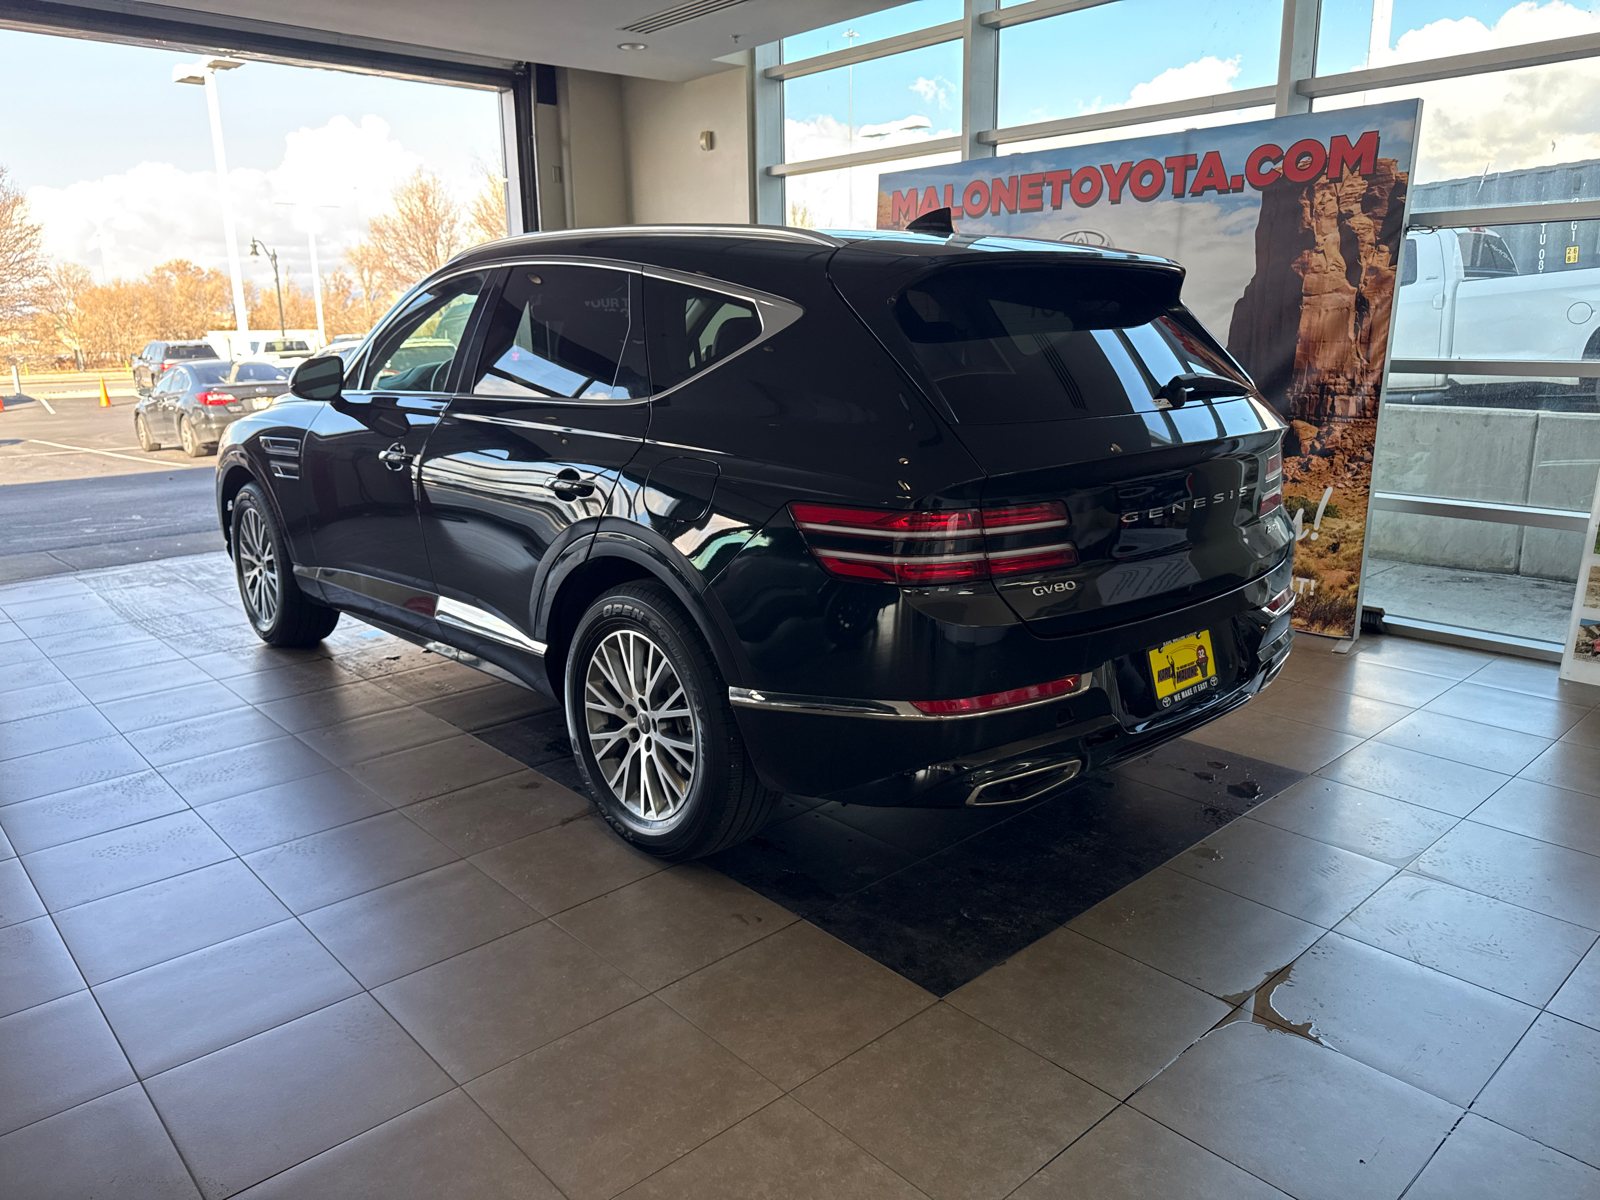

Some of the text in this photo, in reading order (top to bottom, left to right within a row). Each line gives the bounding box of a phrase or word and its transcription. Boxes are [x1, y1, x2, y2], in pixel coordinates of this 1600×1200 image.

[892, 130, 1382, 226] MALONETOYOTA.COM
[1121, 486, 1248, 523] GENESIS
[1032, 580, 1076, 596] GV80
[602, 604, 645, 621] OPEN
[1198, 649, 1205, 658] 32
[1173, 681, 1208, 702] WE MAKE IT EASY
